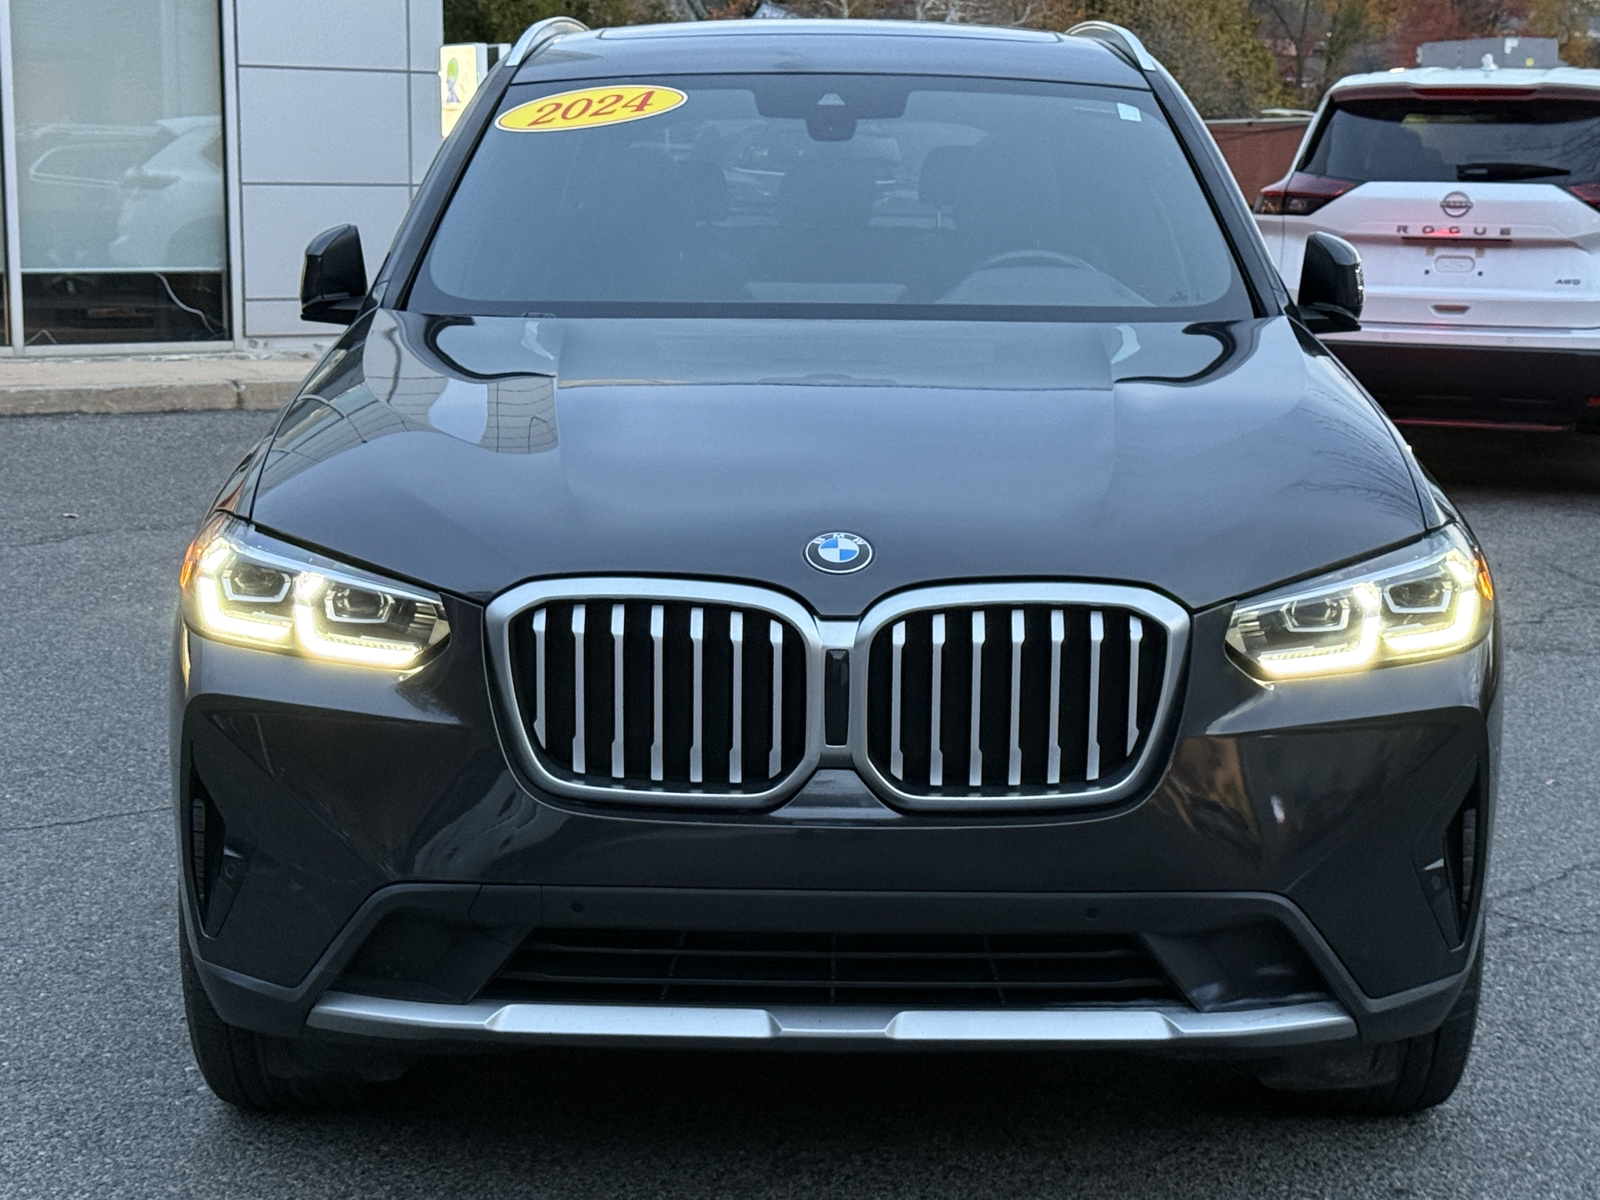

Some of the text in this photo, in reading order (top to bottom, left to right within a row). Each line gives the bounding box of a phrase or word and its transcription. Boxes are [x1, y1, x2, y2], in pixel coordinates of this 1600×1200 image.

[526, 90, 656, 127] 2024
[1396, 225, 1512, 236] ROGUE
[1554, 278, 1581, 286] AWD
